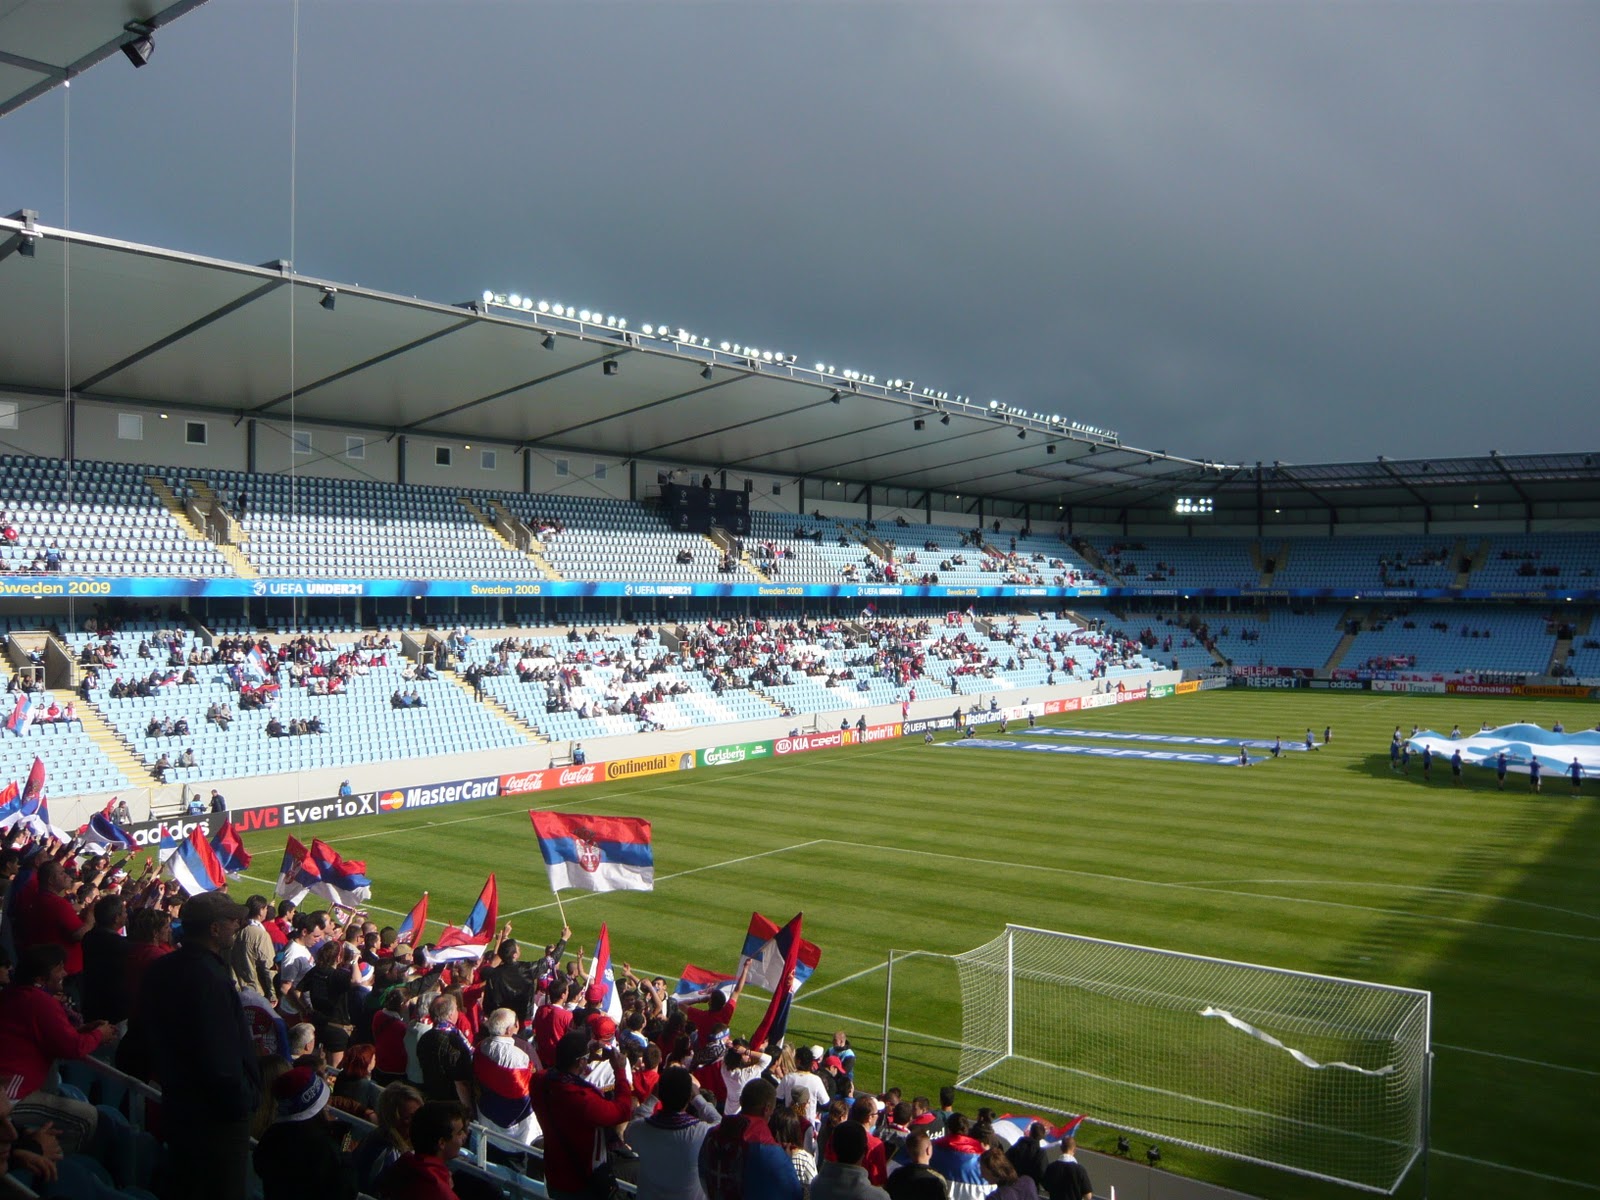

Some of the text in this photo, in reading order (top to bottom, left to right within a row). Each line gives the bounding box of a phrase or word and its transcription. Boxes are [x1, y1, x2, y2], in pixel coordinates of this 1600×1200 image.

[0, 582, 111, 594] Sweden 2009
[270, 583, 363, 595] UEFA UNDER21
[471, 584, 541, 595] Sweden 2009
[635, 585, 692, 595] UEFA UNDER21
[758, 586, 786, 596] Sweden
[1246, 676, 1297, 688] RESPECT
[1329, 680, 1363, 689] adidas
[1390, 682, 1436, 693] TUI Travel
[1456, 684, 1511, 694] McDonald's
[965, 708, 1001, 726] MasterCard
[910, 722, 927, 732] UEFA
[792, 737, 809, 751] KIA
[703, 746, 746, 766] Carlsberg
[1020, 743, 1245, 764] RESPECT
[608, 755, 667, 779] Continental
[406, 777, 499, 808] MasterCard
[235, 807, 280, 832] JVC
